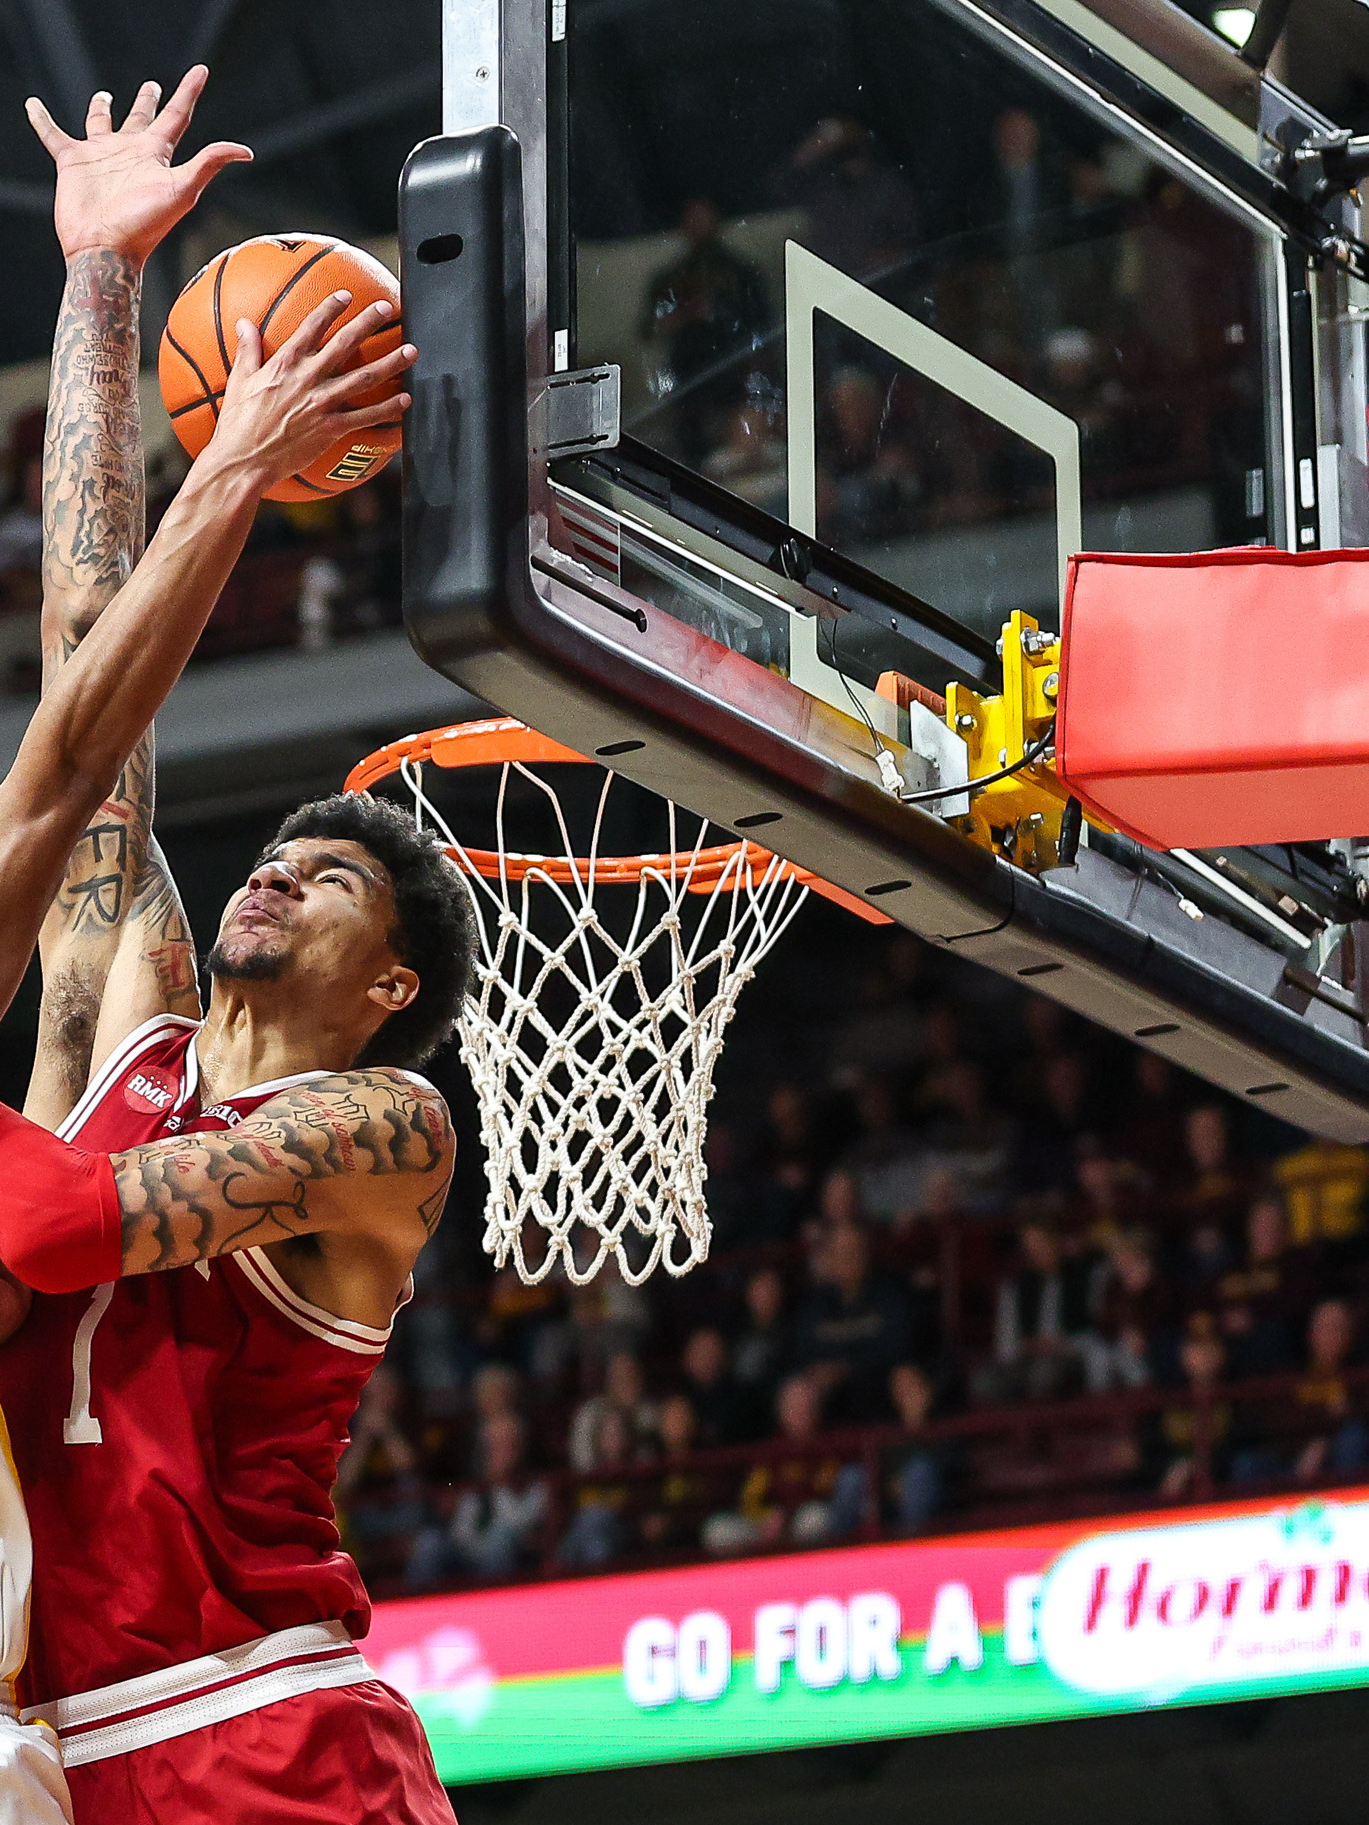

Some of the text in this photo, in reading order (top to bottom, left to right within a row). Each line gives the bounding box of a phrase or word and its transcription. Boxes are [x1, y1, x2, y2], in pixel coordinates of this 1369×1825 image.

[127, 1073, 172, 1108] RMK
[1081, 1558, 1369, 1636] Horm
[624, 1611, 731, 1708] GO
[754, 1592, 902, 1693] FOR
[925, 1581, 983, 1675] A
